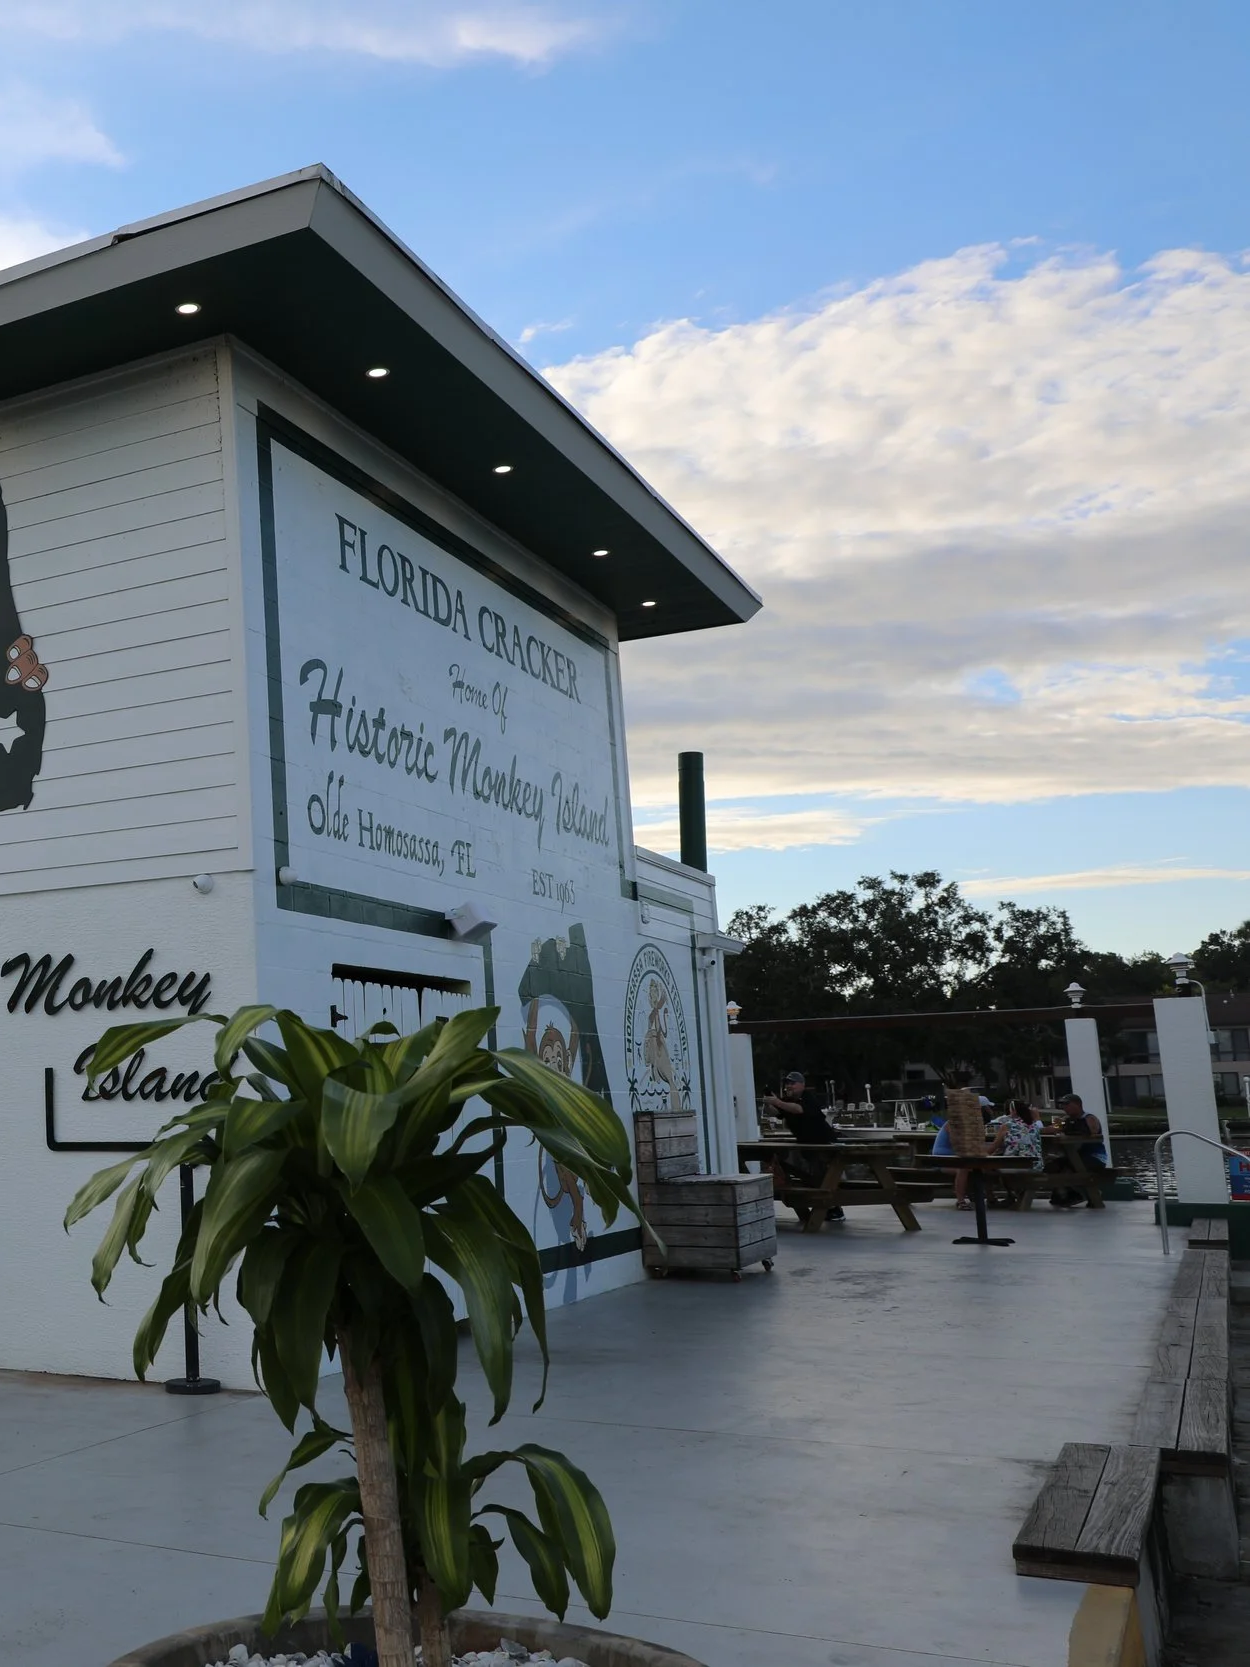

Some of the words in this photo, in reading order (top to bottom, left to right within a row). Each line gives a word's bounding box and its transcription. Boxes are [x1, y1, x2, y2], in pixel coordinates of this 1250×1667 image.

[335, 512, 471, 642] FLORIDA
[478, 605, 582, 704] CRACKER
[448, 663, 489, 710] Home
[492, 681, 508, 735] Of
[299, 658, 439, 784] Historic
[443, 727, 546, 853] Monkey
[551, 772, 610, 848] Island
[357, 808, 445, 877] Homosassa,
[451, 840, 476, 879] FL
[531, 868, 554, 898] EST
[555, 879, 576, 914] 1963
[1, 948, 212, 1016] Monkey
[626, 957, 643, 1053] HOMOSASSA
[643, 950, 671, 986] FIREWORKS
[670, 983, 687, 1052] FESTIVAL
